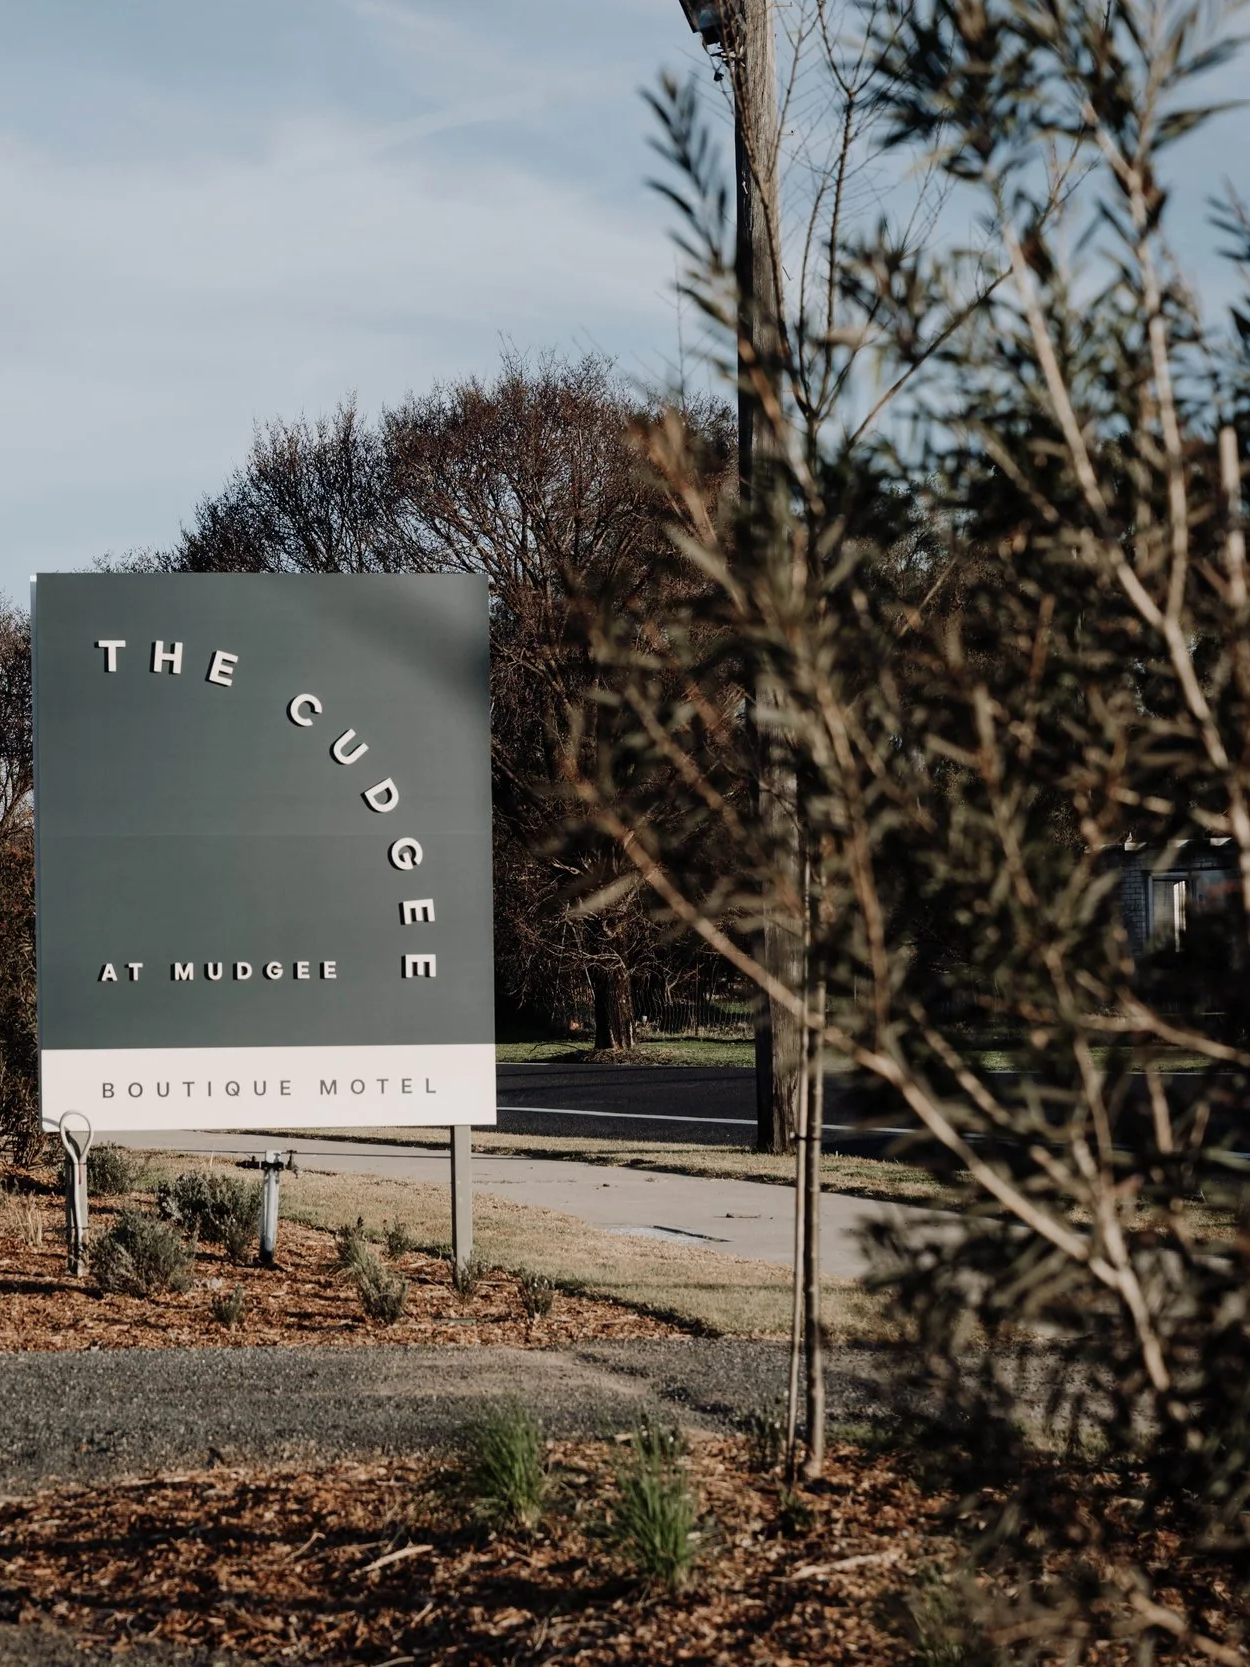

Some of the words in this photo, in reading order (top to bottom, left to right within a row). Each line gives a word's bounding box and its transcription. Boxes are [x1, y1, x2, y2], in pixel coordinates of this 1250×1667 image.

[97, 639, 238, 686] THE
[287, 692, 437, 979] CUDGEE
[99, 962, 143, 982] AT
[172, 960, 338, 981] MUDGEE
[102, 1079, 292, 1099] BOUTIQUE
[319, 1077, 437, 1096] MOTEL
